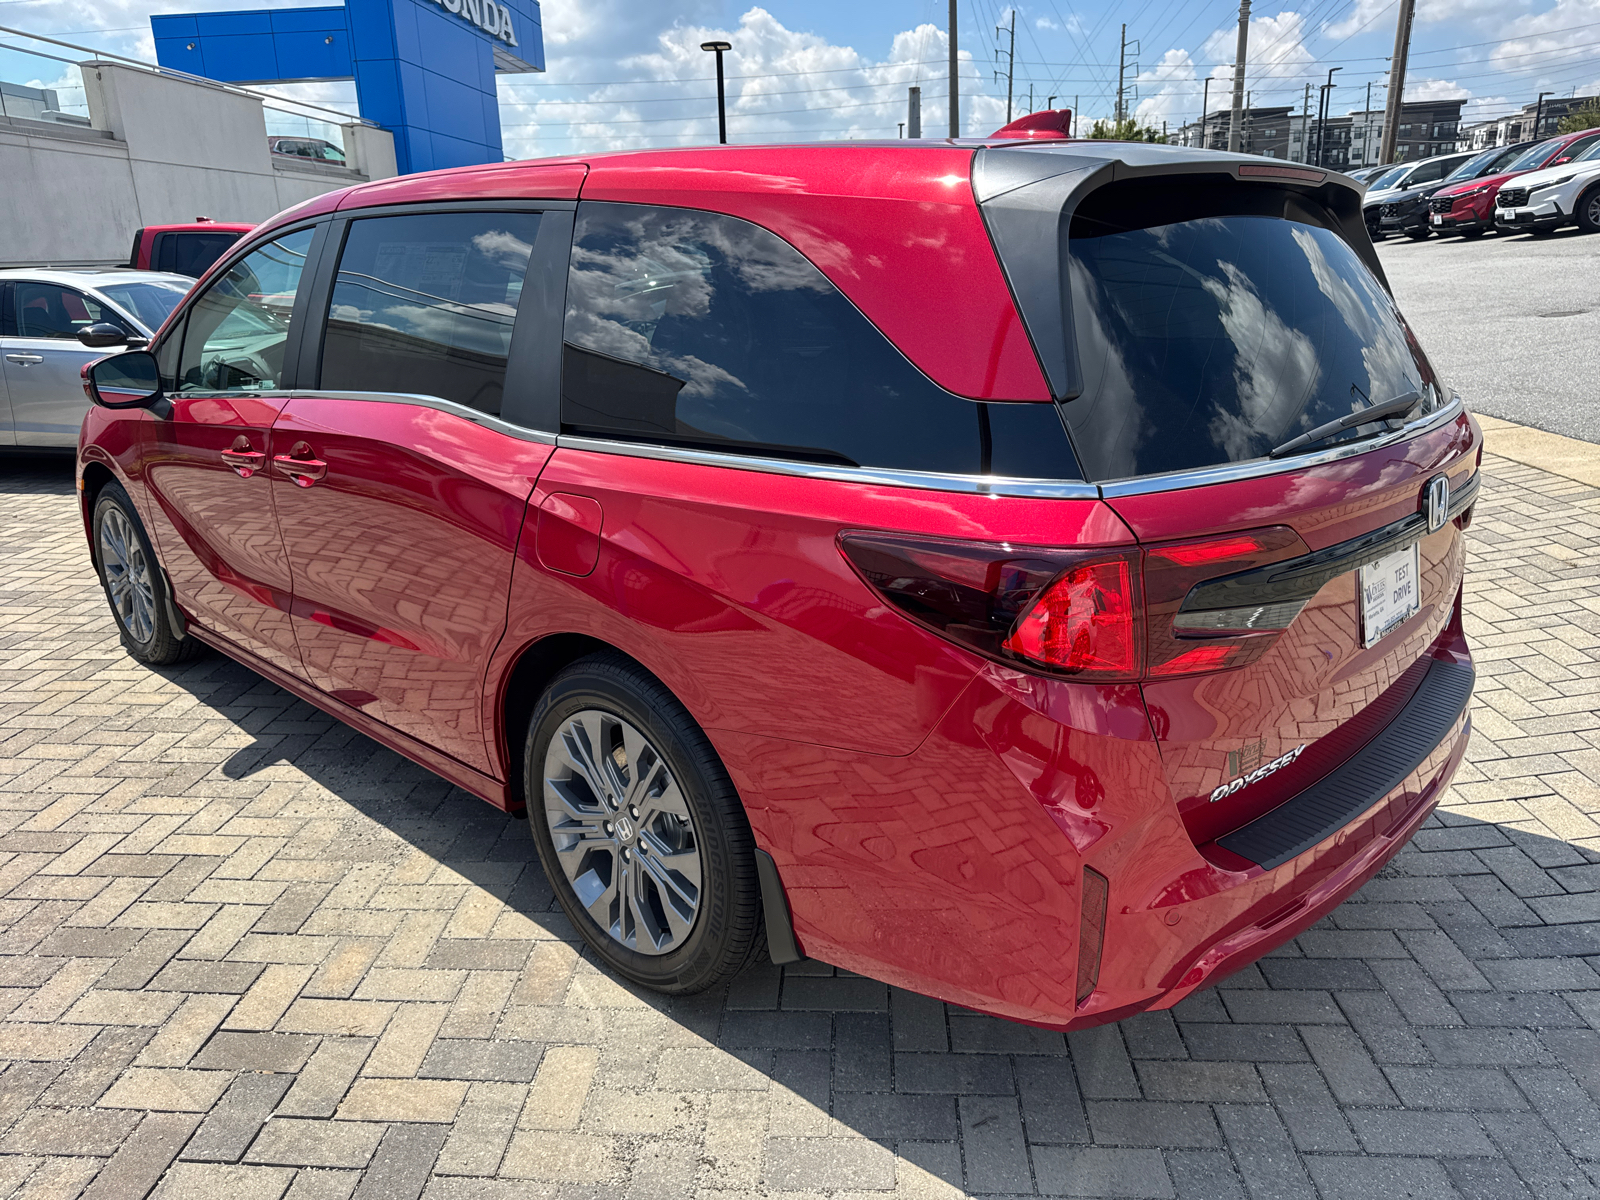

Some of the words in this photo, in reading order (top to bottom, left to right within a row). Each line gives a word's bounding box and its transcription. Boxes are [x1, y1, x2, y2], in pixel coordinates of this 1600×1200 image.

[433, 0, 518, 46] NDA
[1393, 581, 1411, 604] DRIVE
[1394, 563, 1410, 583] TEST
[1208, 743, 1306, 803] ODYSSEY
[695, 792, 724, 943] BRIDGESTONE
